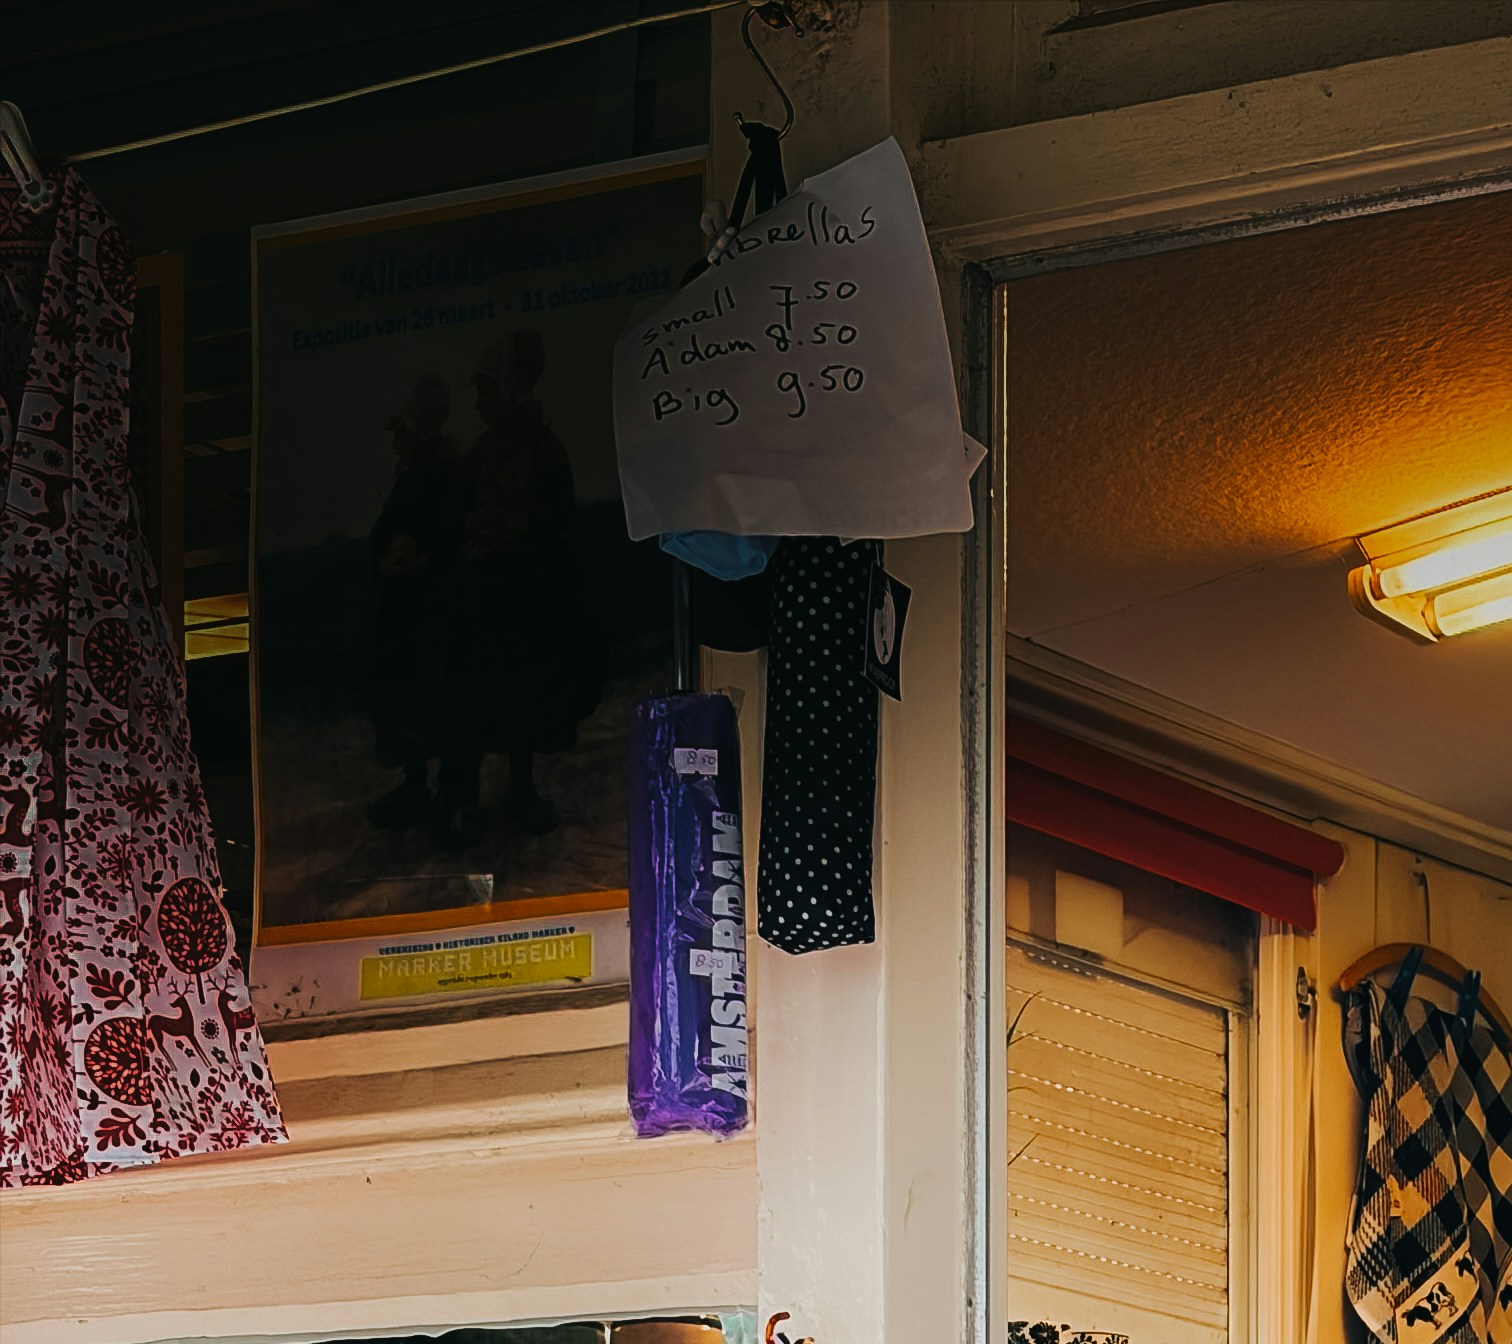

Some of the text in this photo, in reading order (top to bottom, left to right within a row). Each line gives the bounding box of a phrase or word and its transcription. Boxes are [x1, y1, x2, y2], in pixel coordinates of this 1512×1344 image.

[641, 280, 858, 346] small 7.50
[765, 322, 858, 352] 8.50
[652, 364, 865, 426] Big 9.50
[378, 952, 471, 979] MARKER
[483, 940, 576, 968] MUSEUM
